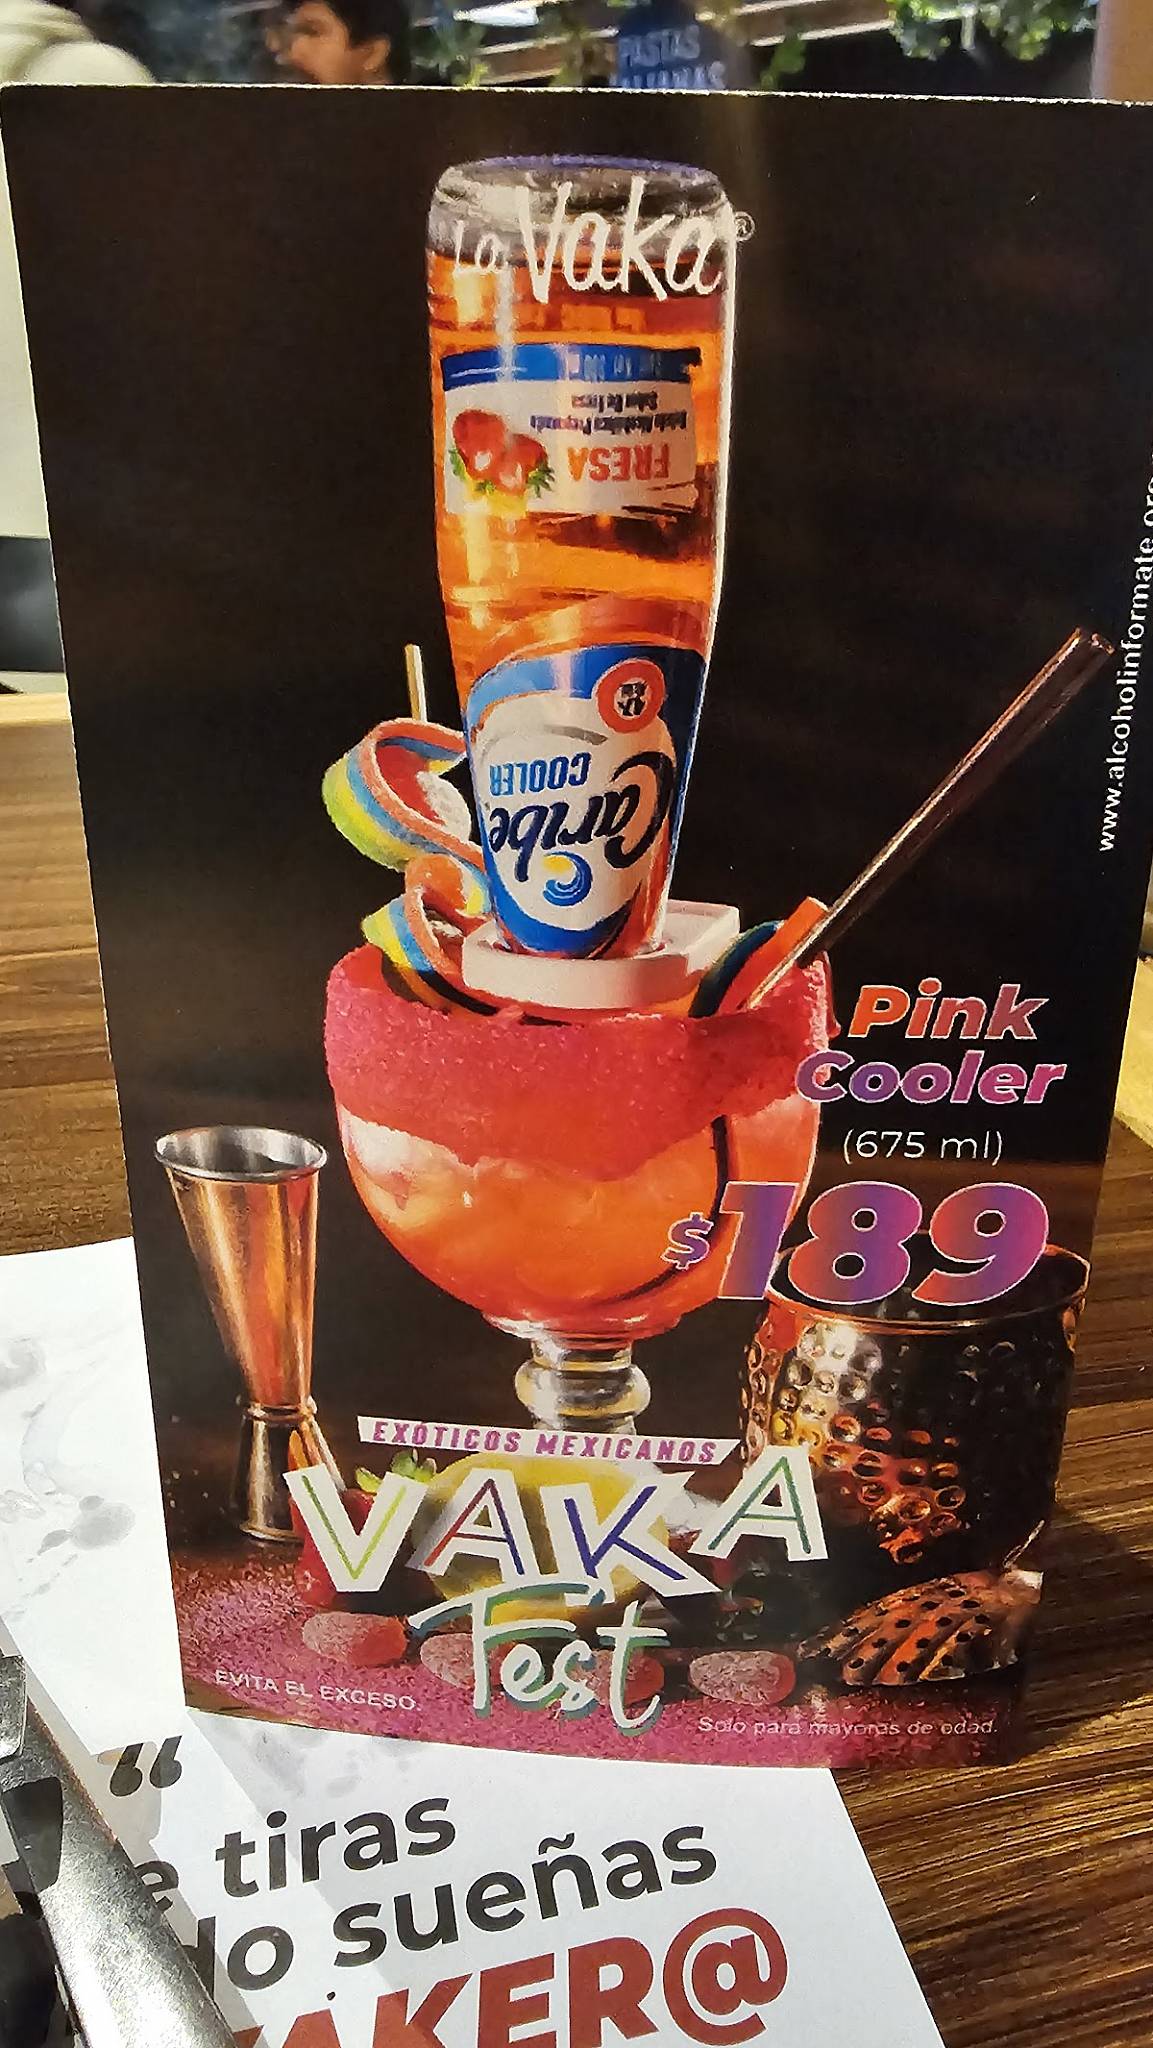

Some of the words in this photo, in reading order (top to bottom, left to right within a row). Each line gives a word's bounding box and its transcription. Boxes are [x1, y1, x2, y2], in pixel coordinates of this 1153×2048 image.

[567, 443, 670, 482] FRESA
[489, 752, 592, 797] COOLER
[488, 751, 676, 883] Caribe
[847, 977, 1050, 1040] Pink
[795, 1049, 1068, 1105] Cooler
[843, 1129, 926, 1166] (675
[940, 1129, 1004, 1166] ml)
[660, 1180, 1050, 1306] $189
[535, 1432, 718, 1464] MEXICANOS
[283, 1444, 829, 1606] VAKA
[214, 1668, 279, 1693] EVITA
[284, 1680, 314, 1698] EL
[406, 1578, 672, 1737] Fest
[753, 1718, 801, 1738] para
[906, 1719, 935, 1736] de
[215, 1796, 457, 1899] tiras
[333, 1825, 718, 1967] sueñas
